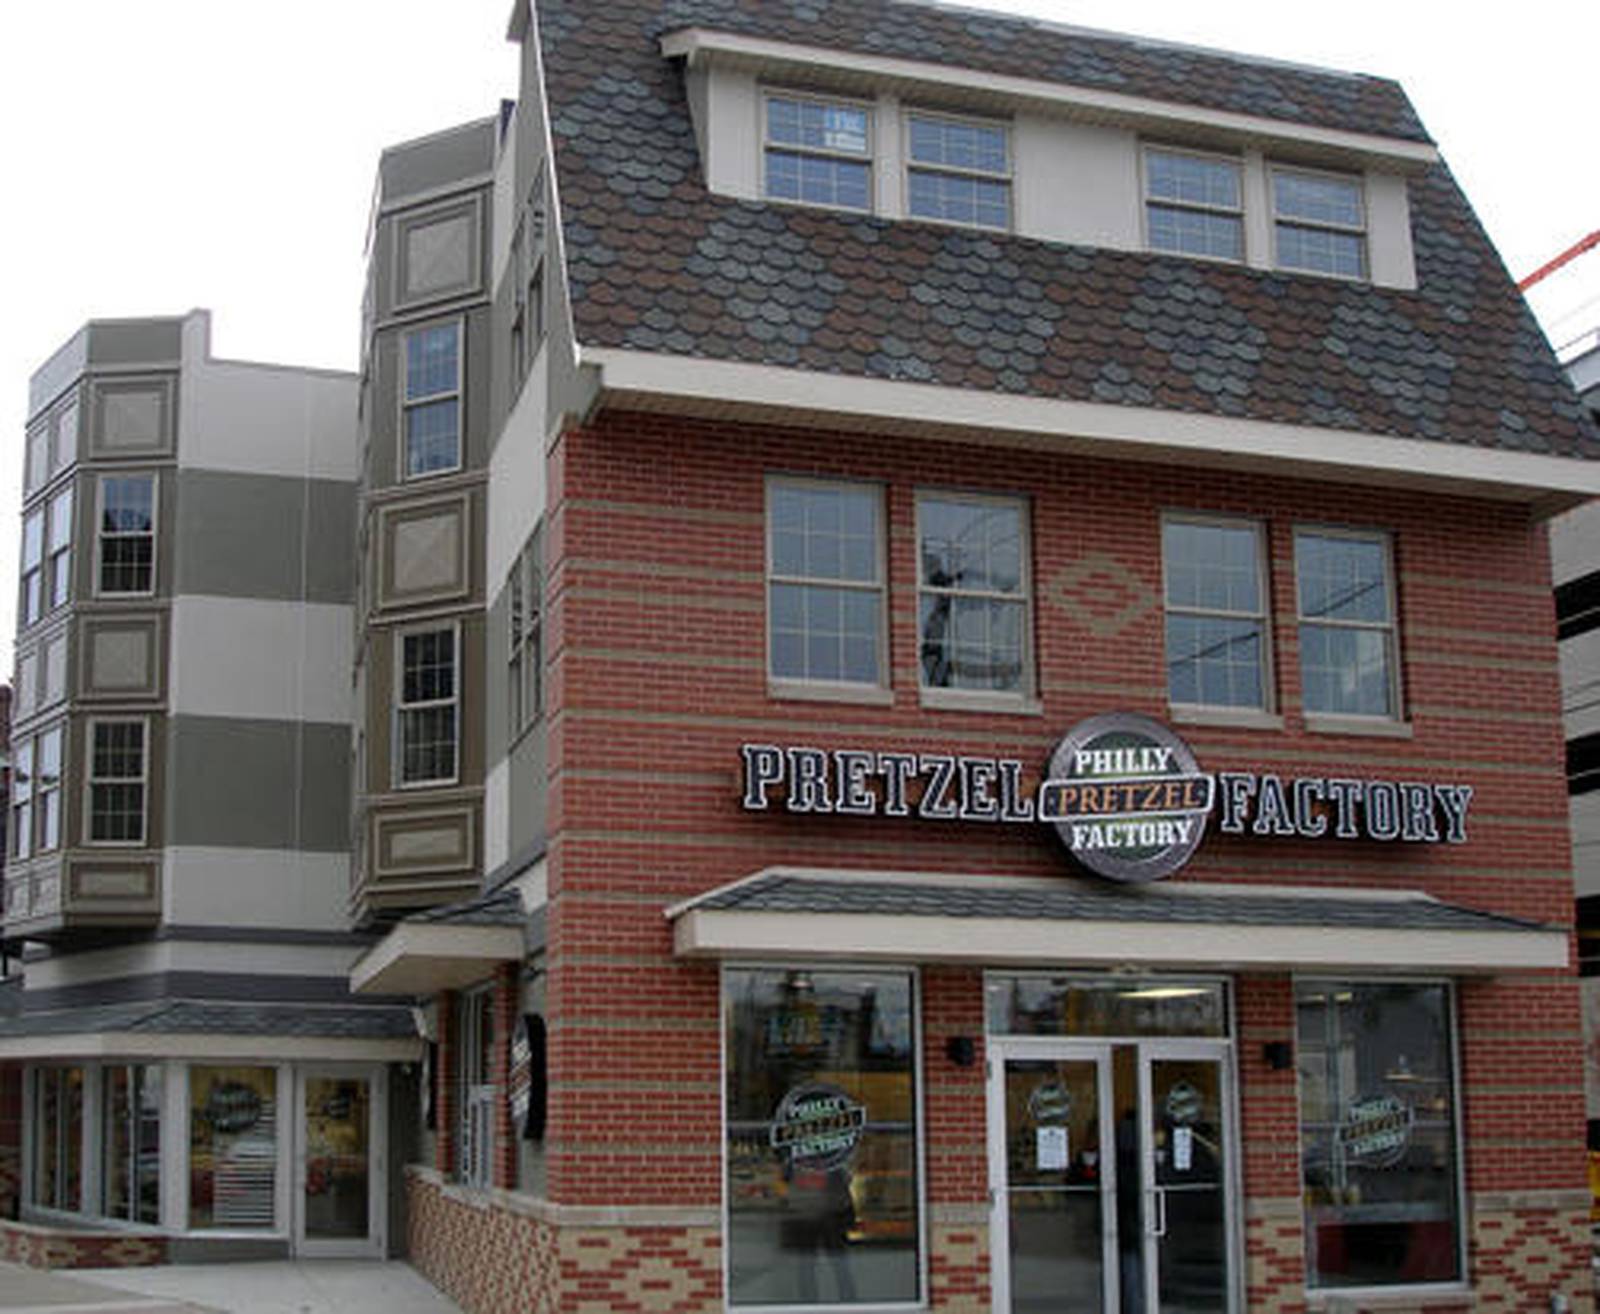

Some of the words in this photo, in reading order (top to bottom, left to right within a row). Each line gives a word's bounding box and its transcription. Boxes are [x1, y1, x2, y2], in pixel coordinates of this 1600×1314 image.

[1074, 746, 1174, 777] PHILLY
[743, 743, 1035, 822] PRETZEL
[1057, 780, 1197, 816] PRETZEL
[1218, 772, 1474, 844] FACTORY
[1070, 819, 1195, 852] FACTORY
